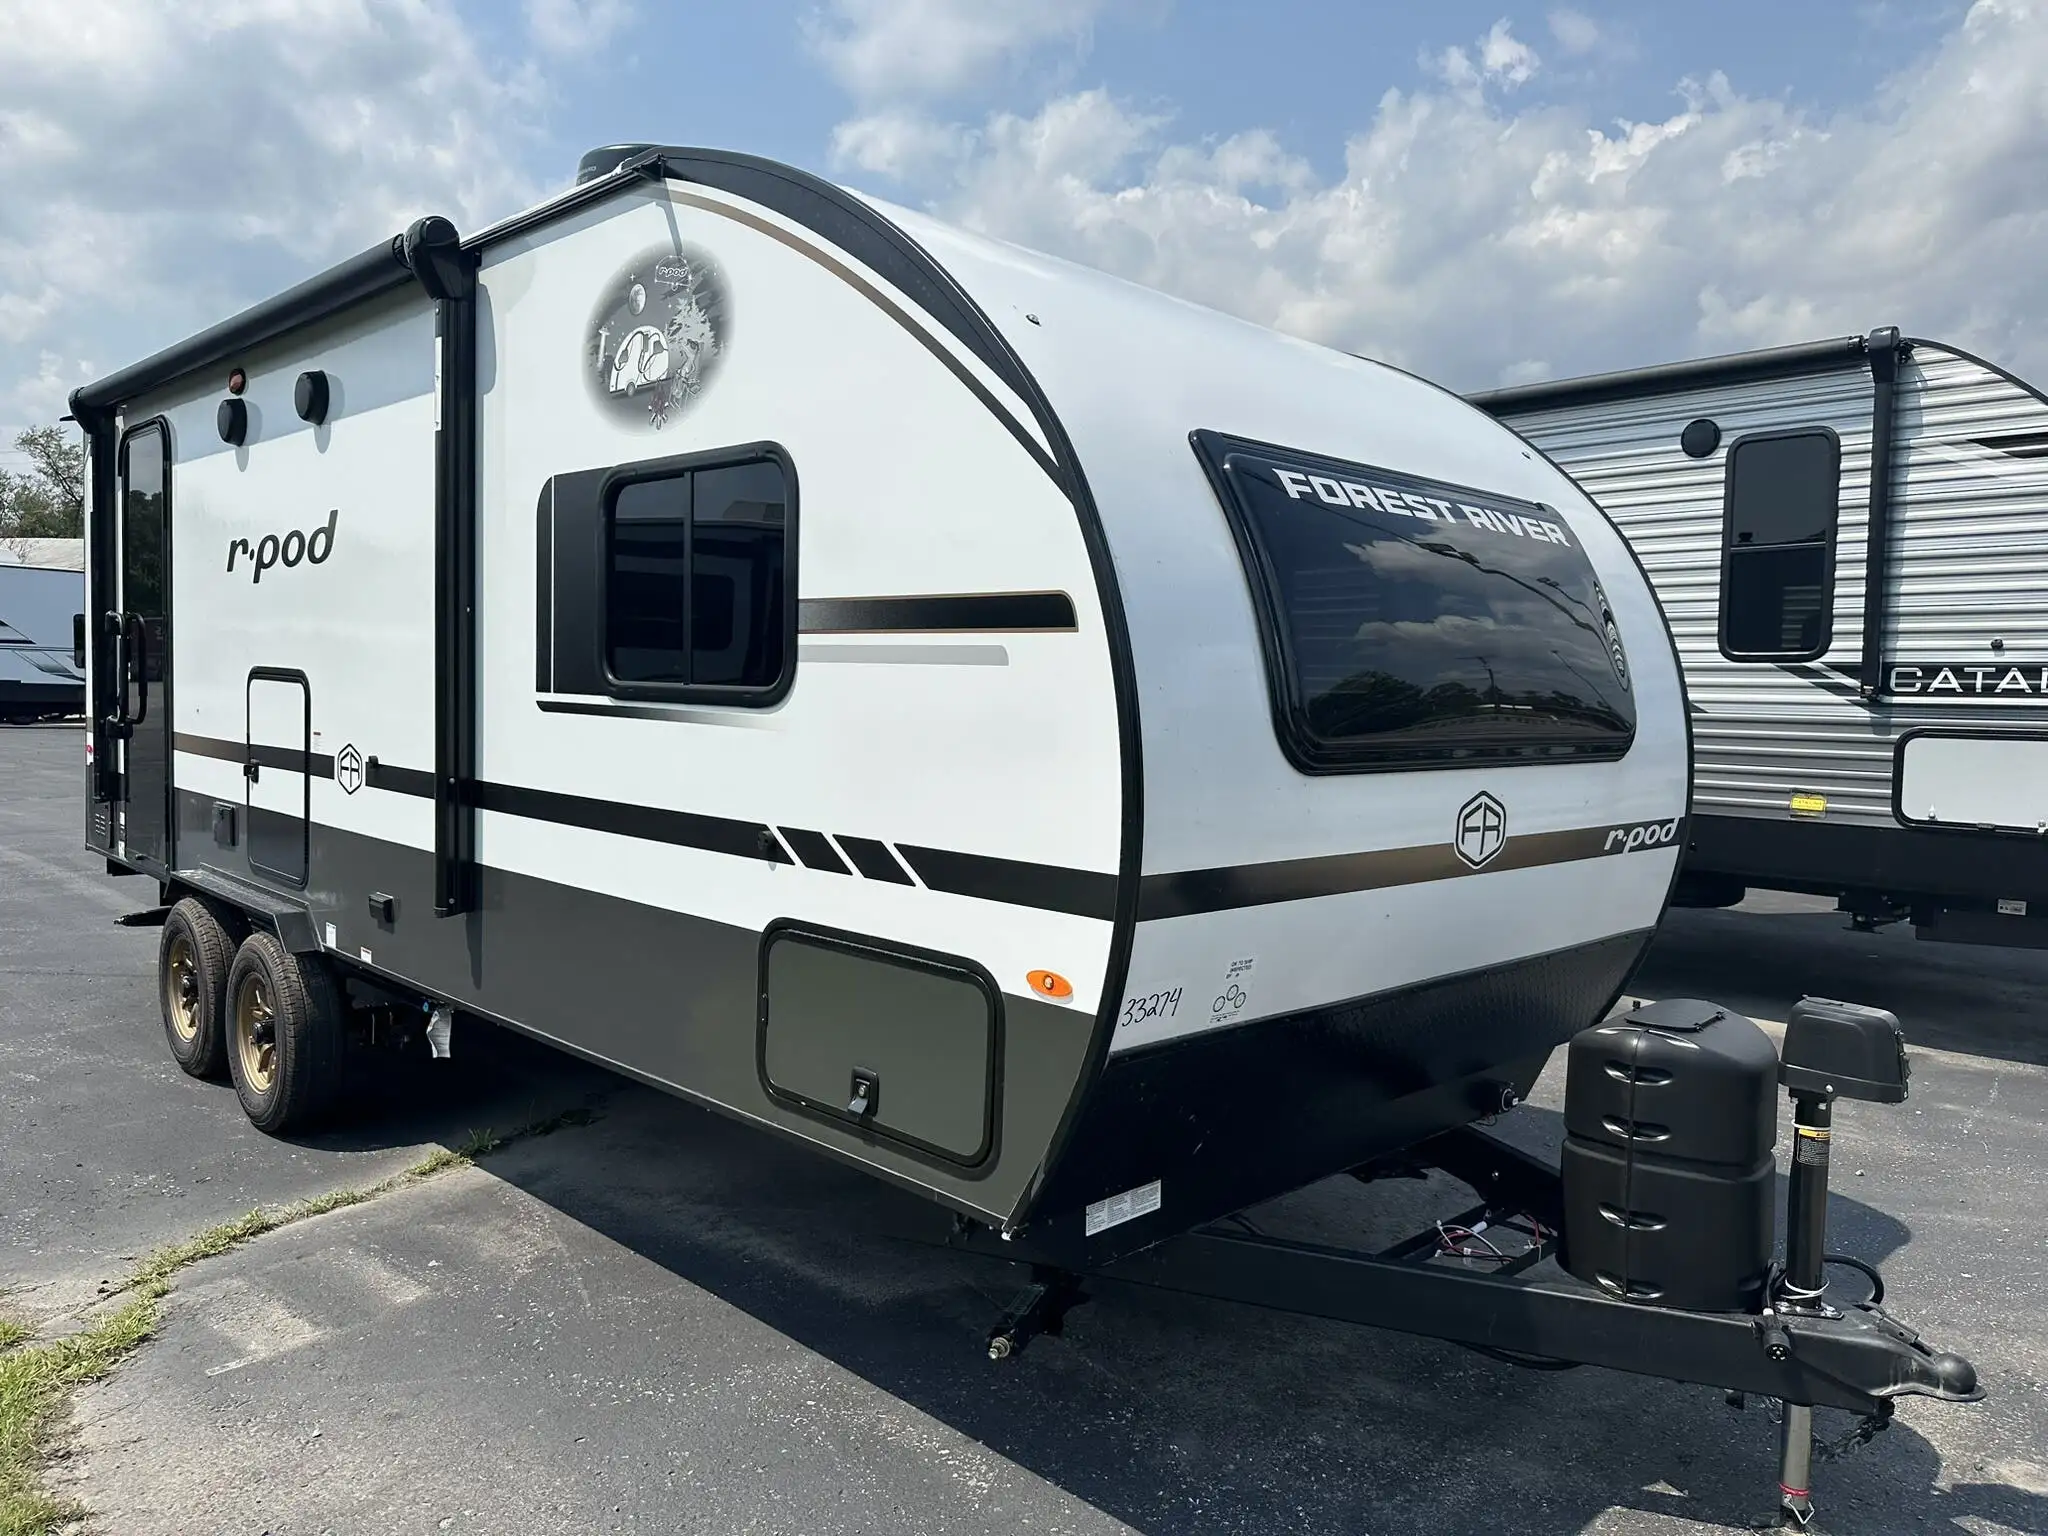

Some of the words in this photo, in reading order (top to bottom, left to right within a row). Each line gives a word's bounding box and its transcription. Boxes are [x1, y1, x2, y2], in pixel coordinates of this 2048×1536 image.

[1272, 468, 1457, 524] FOREST
[1456, 503, 1572, 548] RIVER
[1121, 987, 1183, 1027] 33274
